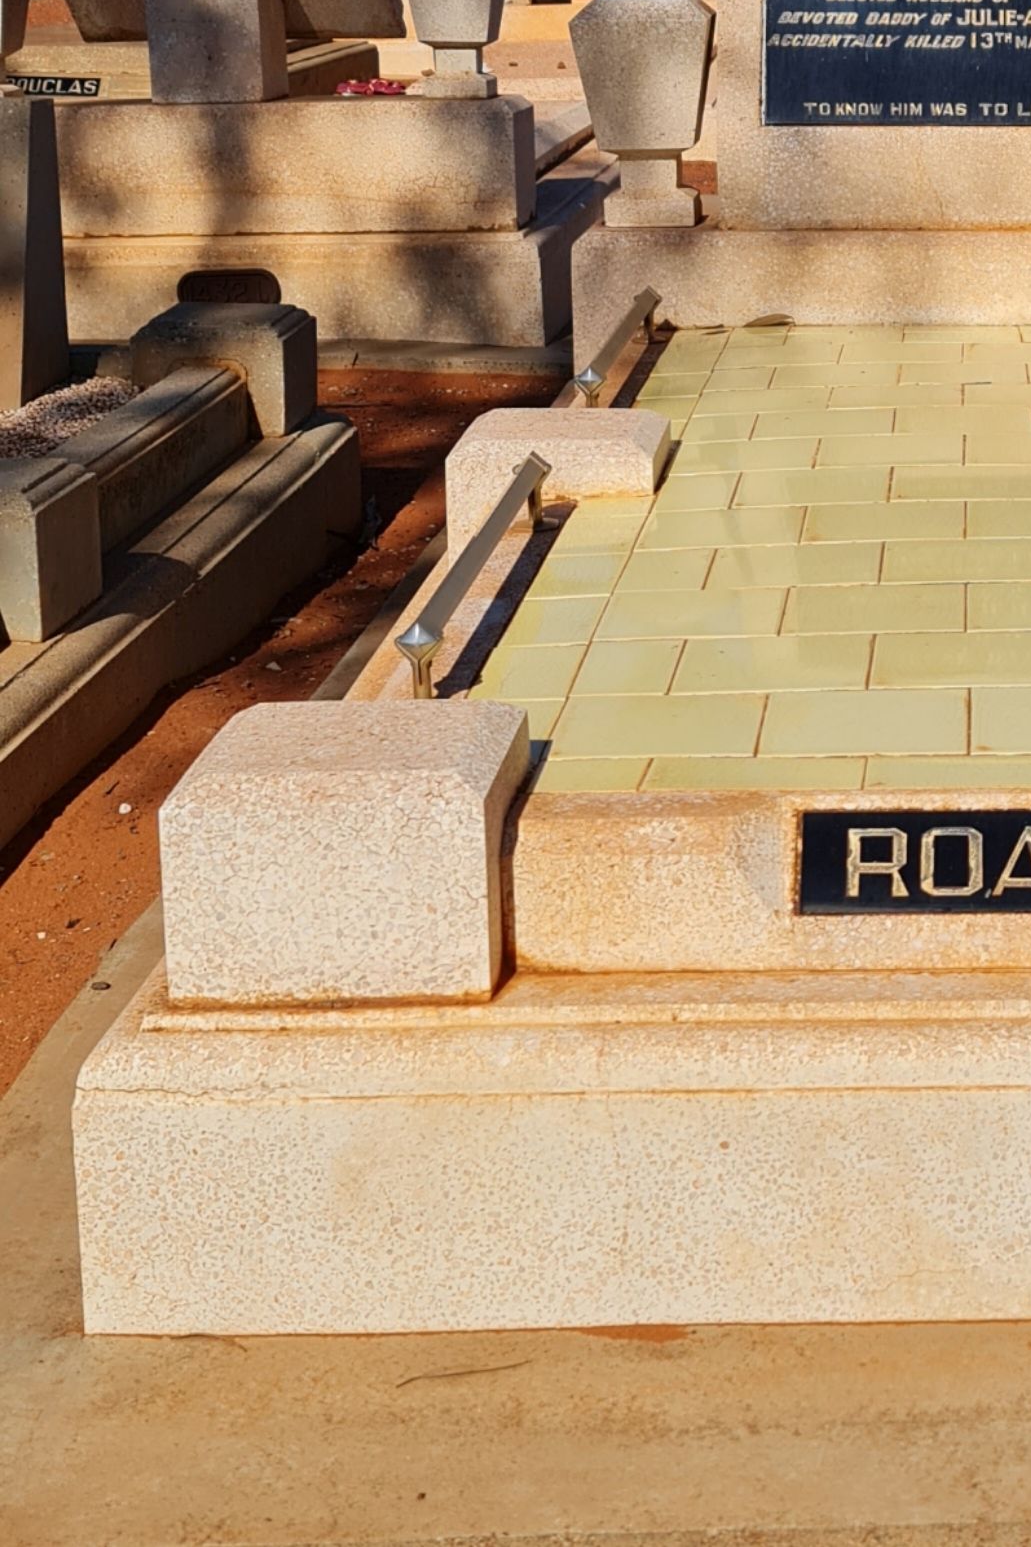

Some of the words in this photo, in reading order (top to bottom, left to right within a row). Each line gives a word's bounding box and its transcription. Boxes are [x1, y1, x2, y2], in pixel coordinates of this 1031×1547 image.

[778, 11, 859, 25] DEVOTED
[865, 12, 927, 26] DADDY
[930, 13, 952, 25] OF
[767, 34, 900, 48] ACCIDENTALLY
[905, 34, 966, 48] KILLED
[803, 102, 831, 116] TO
[835, 102, 883, 116] KNOW
[890, 102, 923, 116] HIM
[930, 102, 967, 116] WAS
[979, 103, 1008, 116] TO
